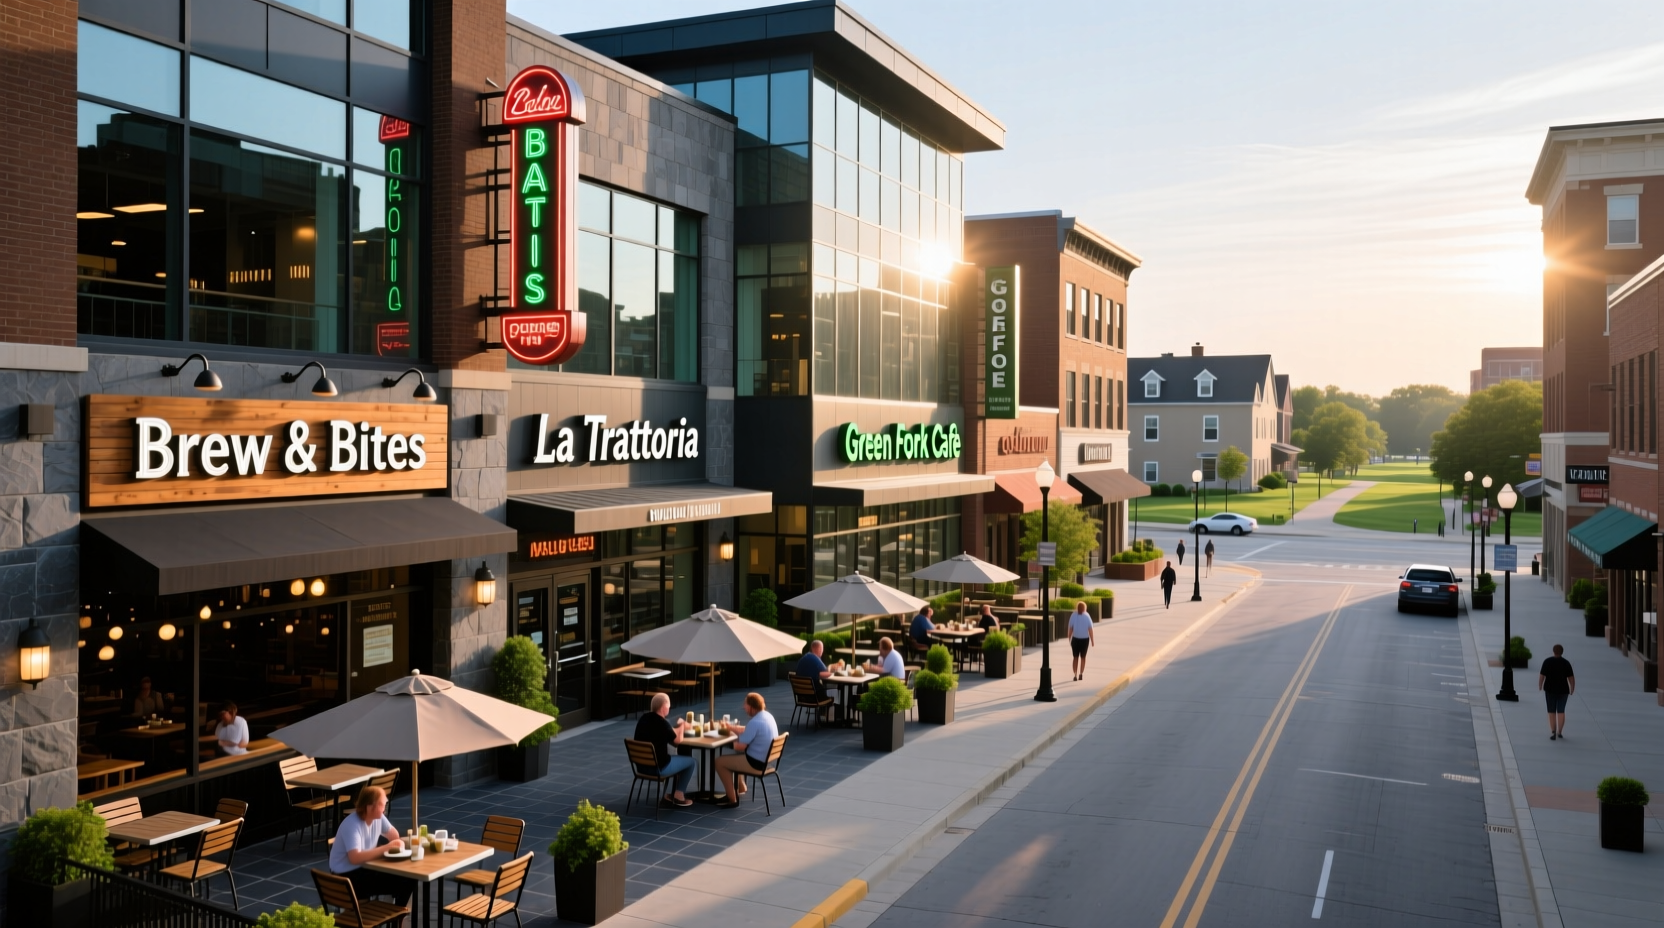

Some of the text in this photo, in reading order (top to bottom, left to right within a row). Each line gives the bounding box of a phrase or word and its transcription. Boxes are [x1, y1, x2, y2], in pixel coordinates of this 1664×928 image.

[522, 128, 546, 304] BATIS
[135, 417, 427, 479] Brew & Bites
[533, 413, 698, 464] La Trattoria
[845, 422, 892, 462] Green
[895, 422, 930, 460] Fork
